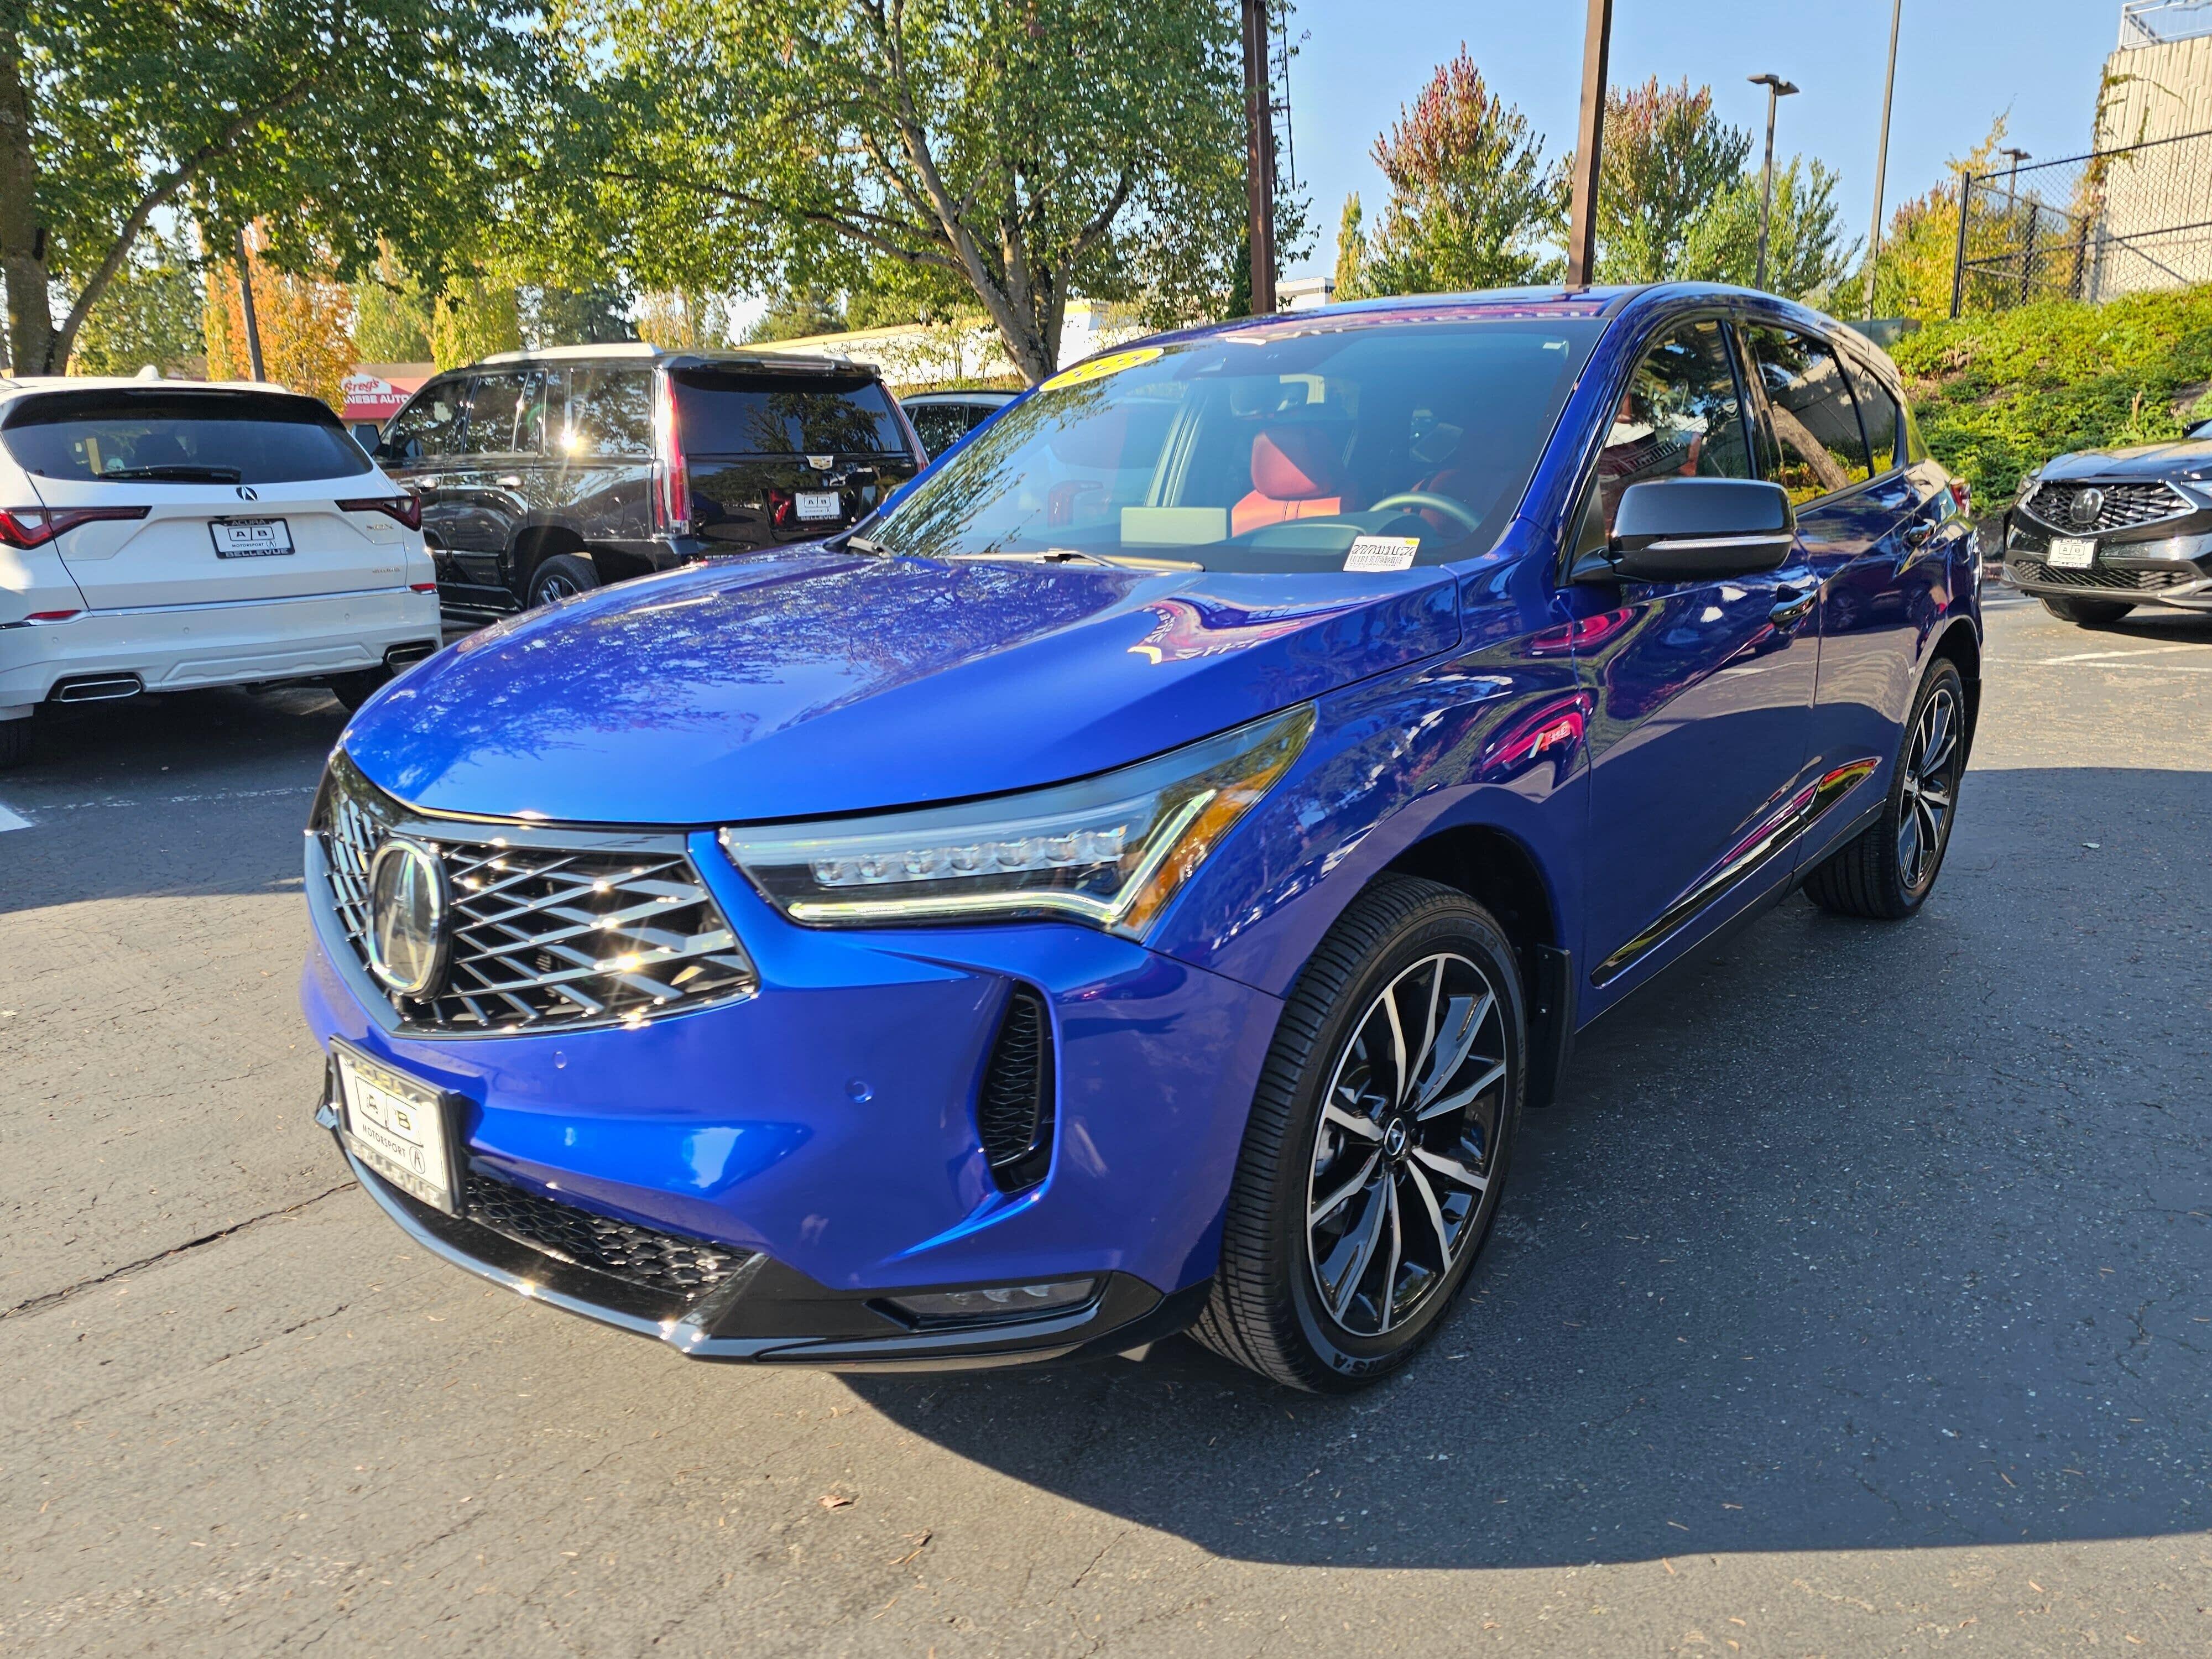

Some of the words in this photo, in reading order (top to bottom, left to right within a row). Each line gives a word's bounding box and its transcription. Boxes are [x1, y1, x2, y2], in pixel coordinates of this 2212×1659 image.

[344, 378, 379, 392] Greg's
[379, 394, 410, 404] AUTO
[225, 548, 288, 558] BELLEVUE
[395, 1108, 411, 1131] B
[362, 1123, 406, 1157] MOTORSPORT
